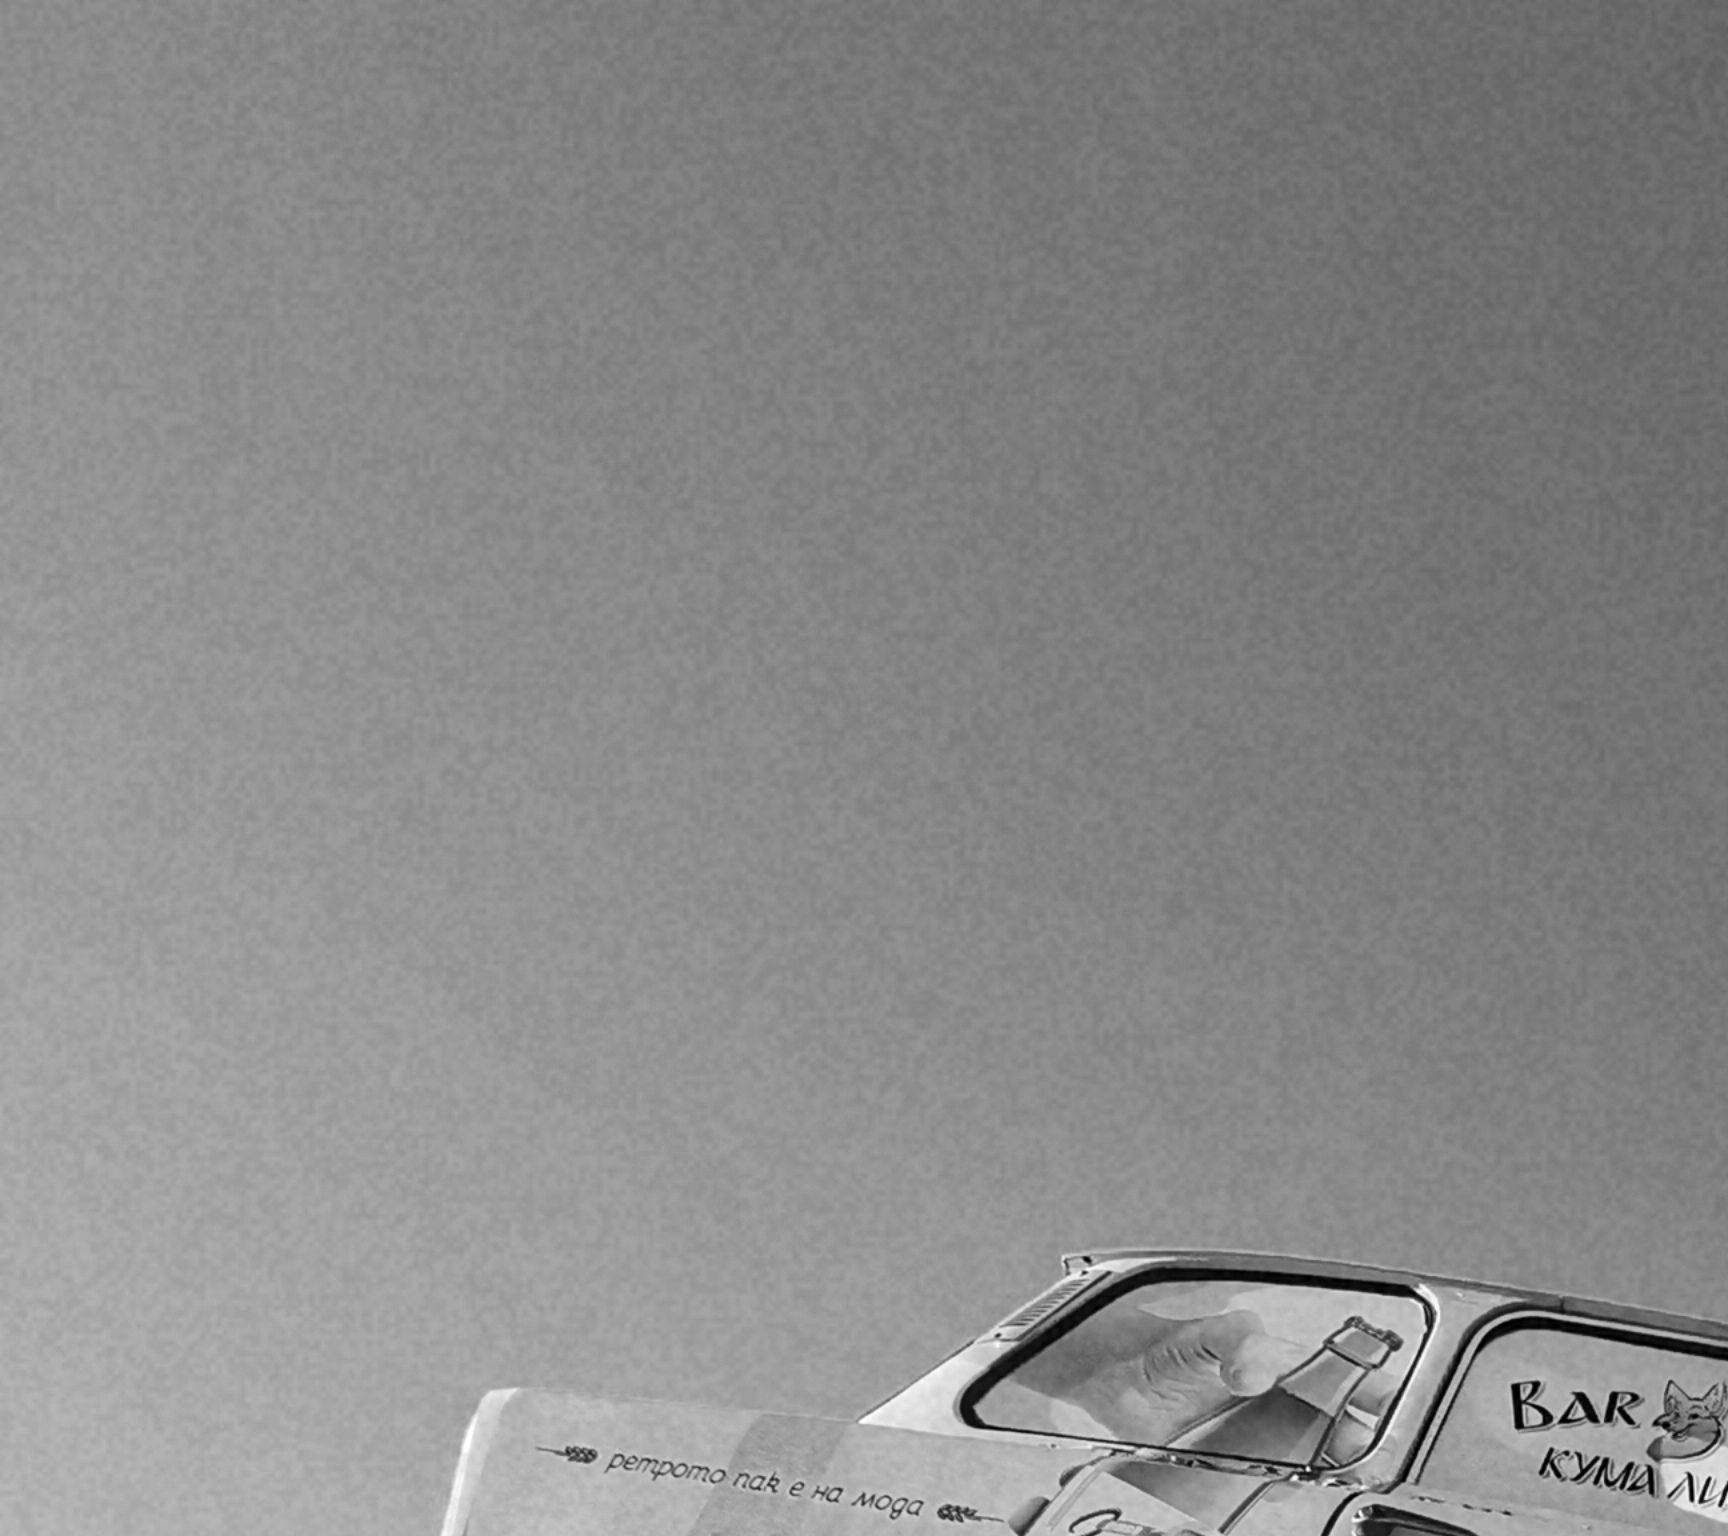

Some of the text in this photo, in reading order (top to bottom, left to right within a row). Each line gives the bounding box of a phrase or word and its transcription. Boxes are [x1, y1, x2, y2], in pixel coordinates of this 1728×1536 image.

[604, 1448, 727, 1491] ретрото
[732, 1469, 782, 1496] пак
[788, 1480, 806, 1499] е
[811, 1483, 844, 1504] на
